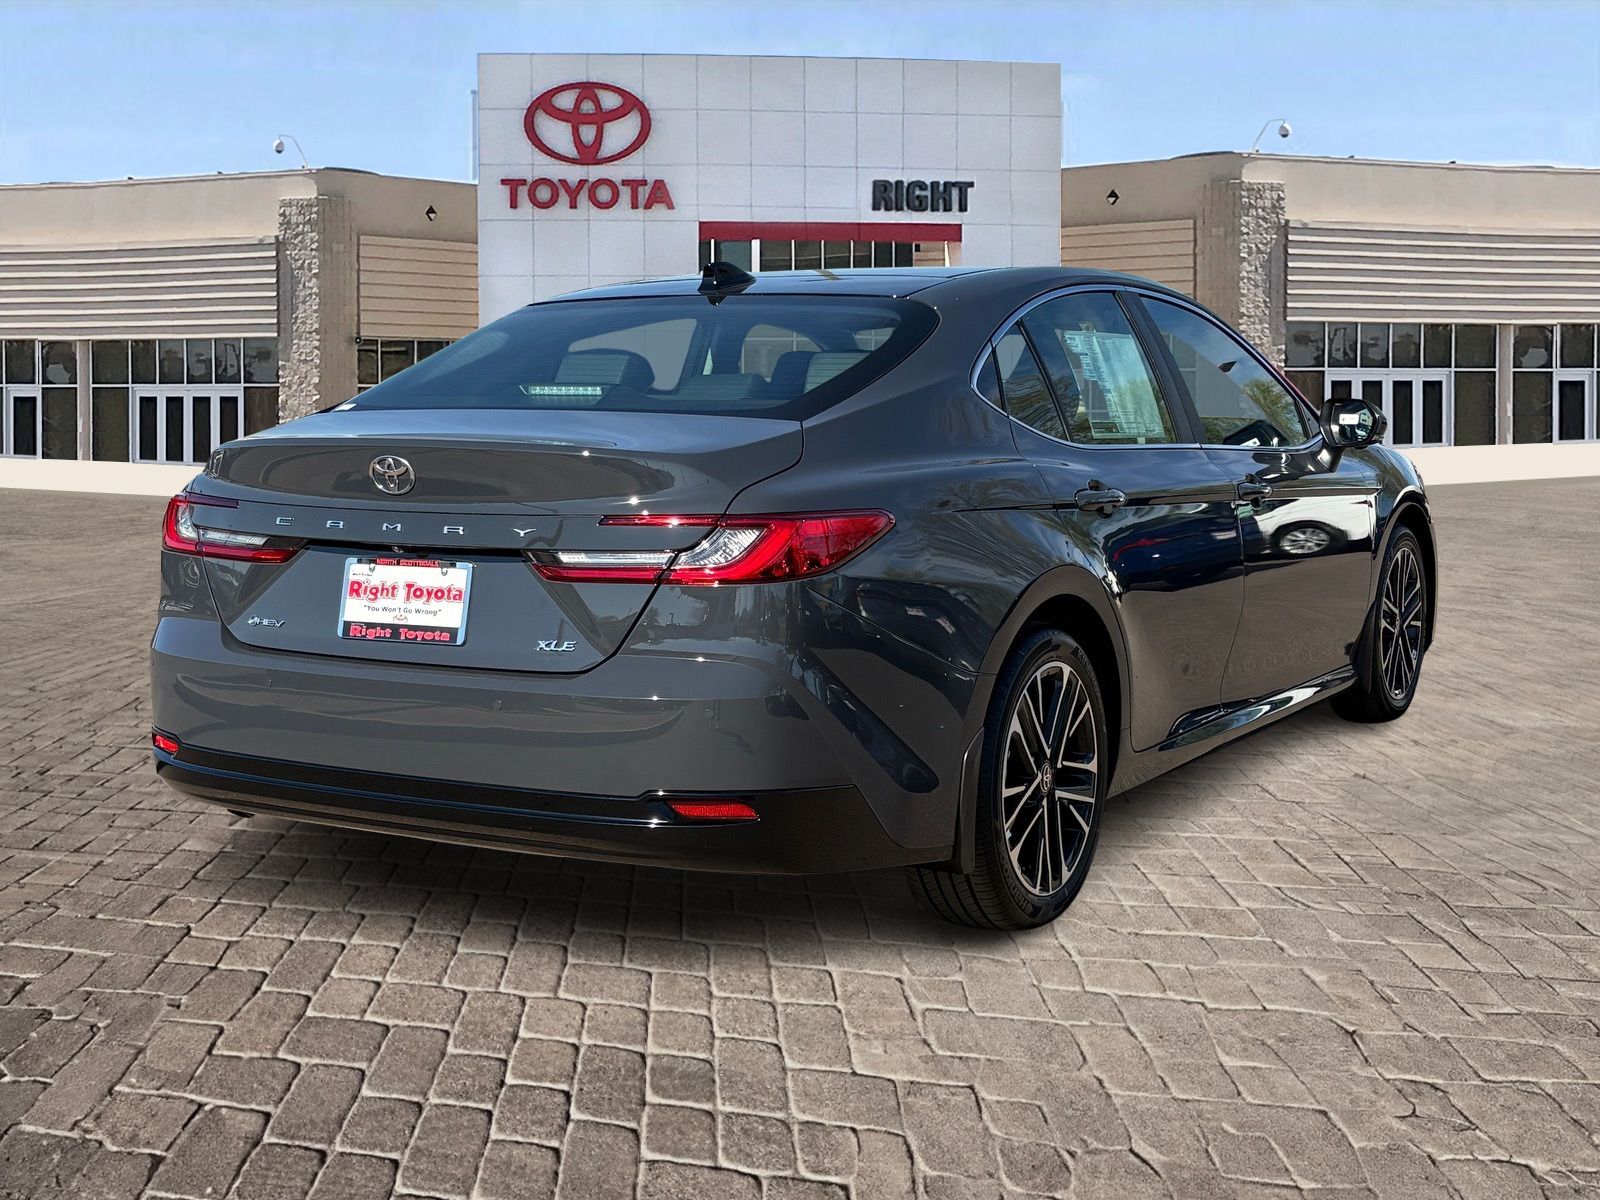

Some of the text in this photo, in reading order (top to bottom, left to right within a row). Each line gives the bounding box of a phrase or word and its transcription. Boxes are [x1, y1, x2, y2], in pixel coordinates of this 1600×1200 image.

[500, 177, 676, 210] TOYOTA
[872, 179, 975, 213] RIGHT
[275, 516, 537, 538] CAMRY
[348, 580, 463, 604] Right Toyota
[381, 605, 402, 614] Won't
[403, 607, 413, 615] Go
[349, 624, 451, 642] Right Toyota
[534, 640, 577, 652] XLE
